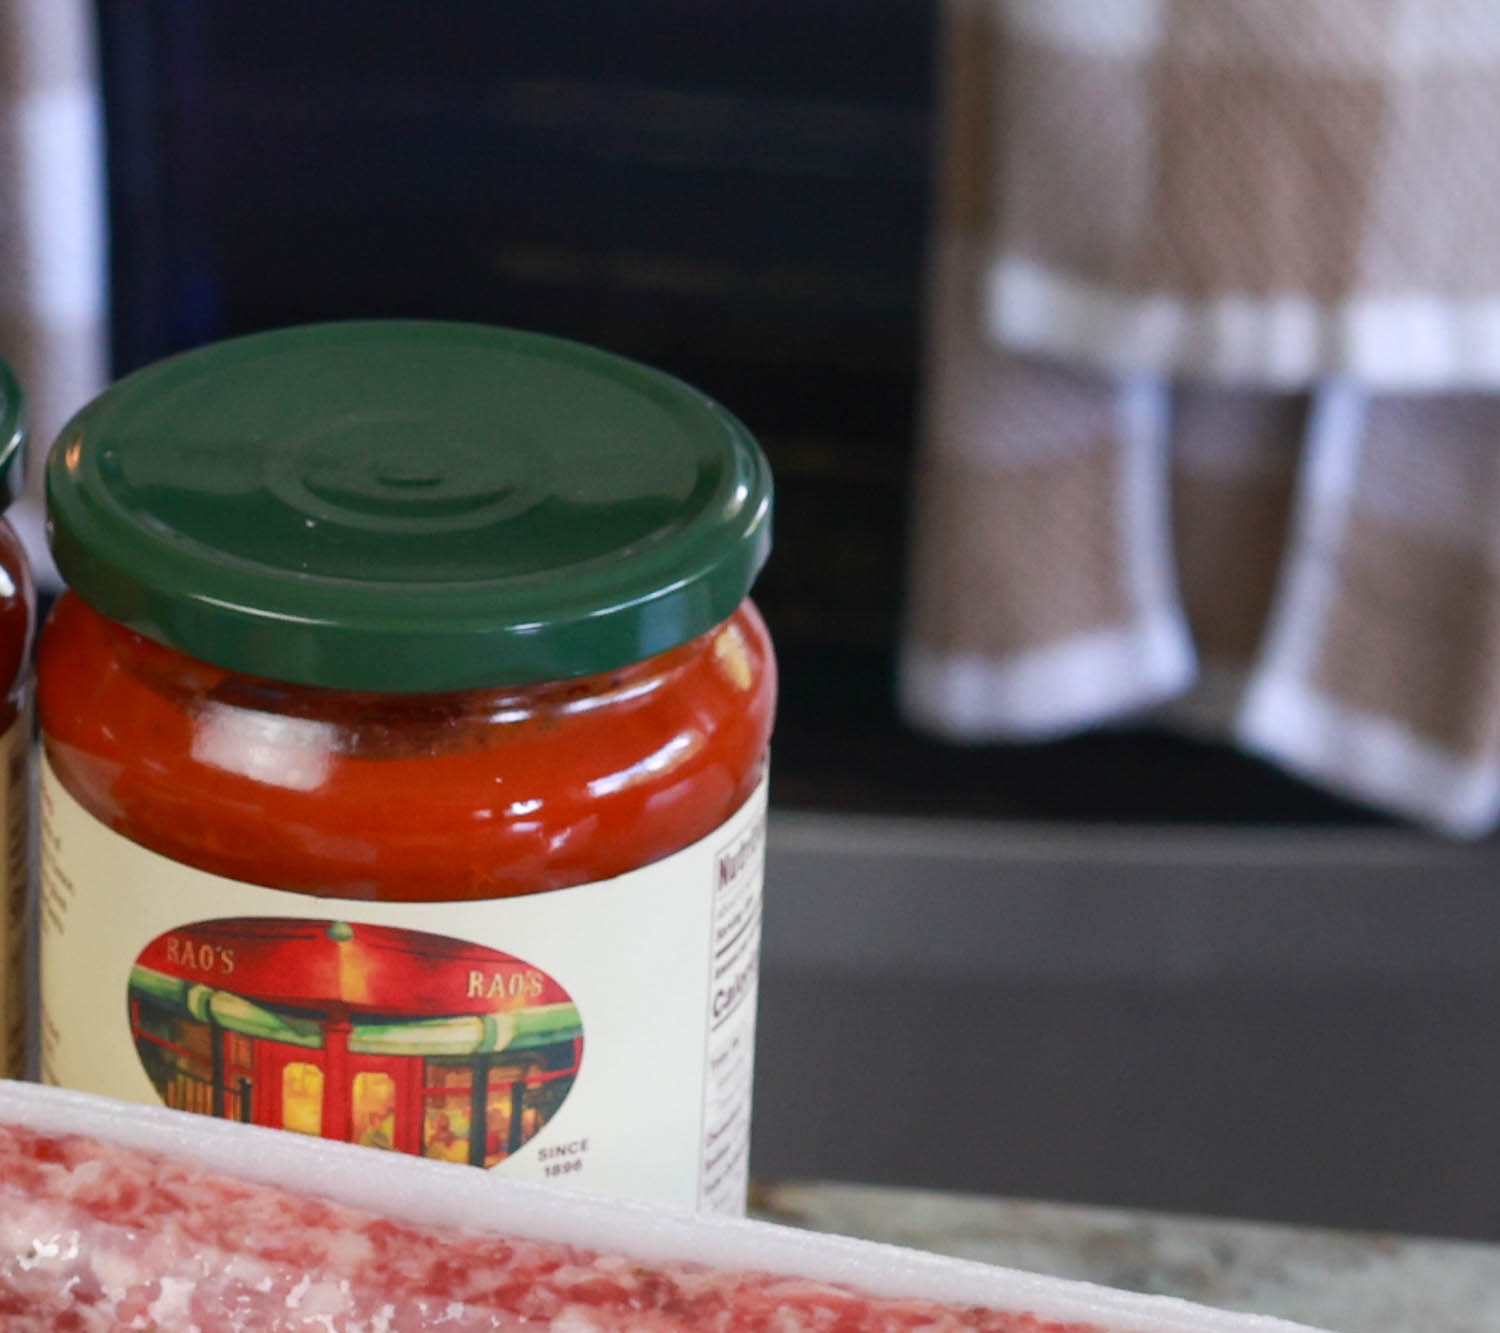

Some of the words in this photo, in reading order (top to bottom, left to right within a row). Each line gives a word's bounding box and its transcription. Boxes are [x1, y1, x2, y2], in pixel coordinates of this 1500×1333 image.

[165, 936, 236, 975] RAO'S
[467, 969, 545, 1000] RAO'S
[538, 1136, 591, 1163] SINCE
